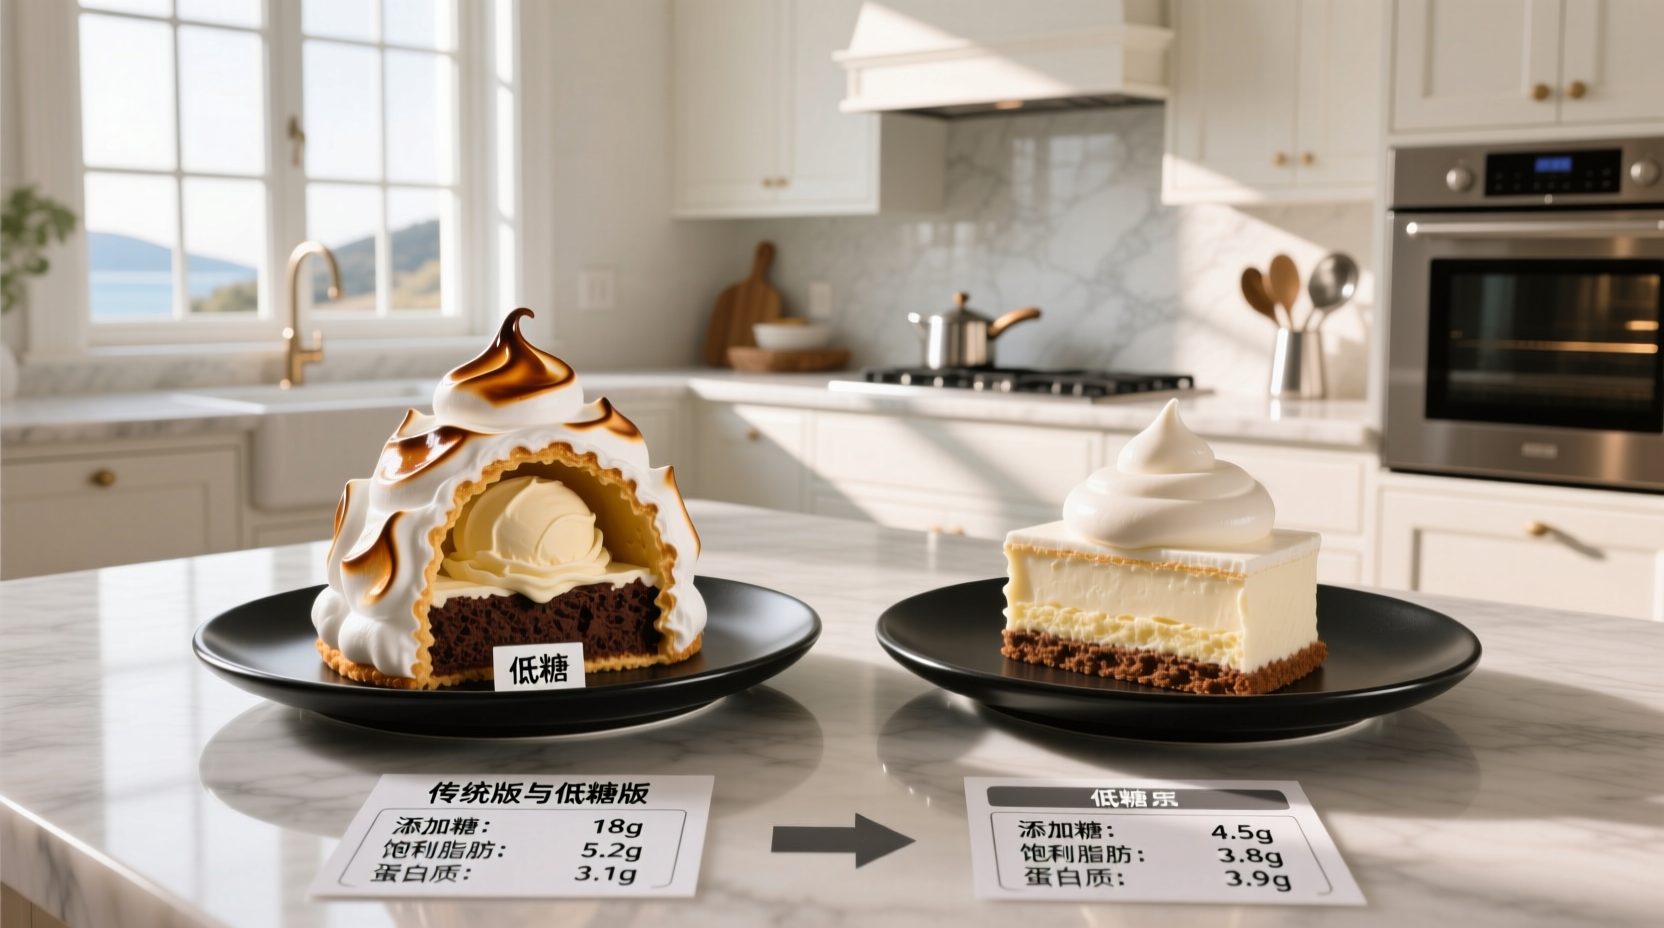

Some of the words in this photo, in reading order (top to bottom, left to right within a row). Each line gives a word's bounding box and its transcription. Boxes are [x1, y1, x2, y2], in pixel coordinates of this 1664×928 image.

[509, 653, 570, 685] 低糖
[429, 781, 650, 804] 传统版与低糖版
[594, 819, 643, 838] 18g
[1212, 825, 1273, 844] 4.5g
[582, 843, 642, 862] 5.2g
[1218, 848, 1283, 868] 3.8g
[575, 866, 636, 885] 3.1g
[1225, 870, 1291, 892] 3.9g
